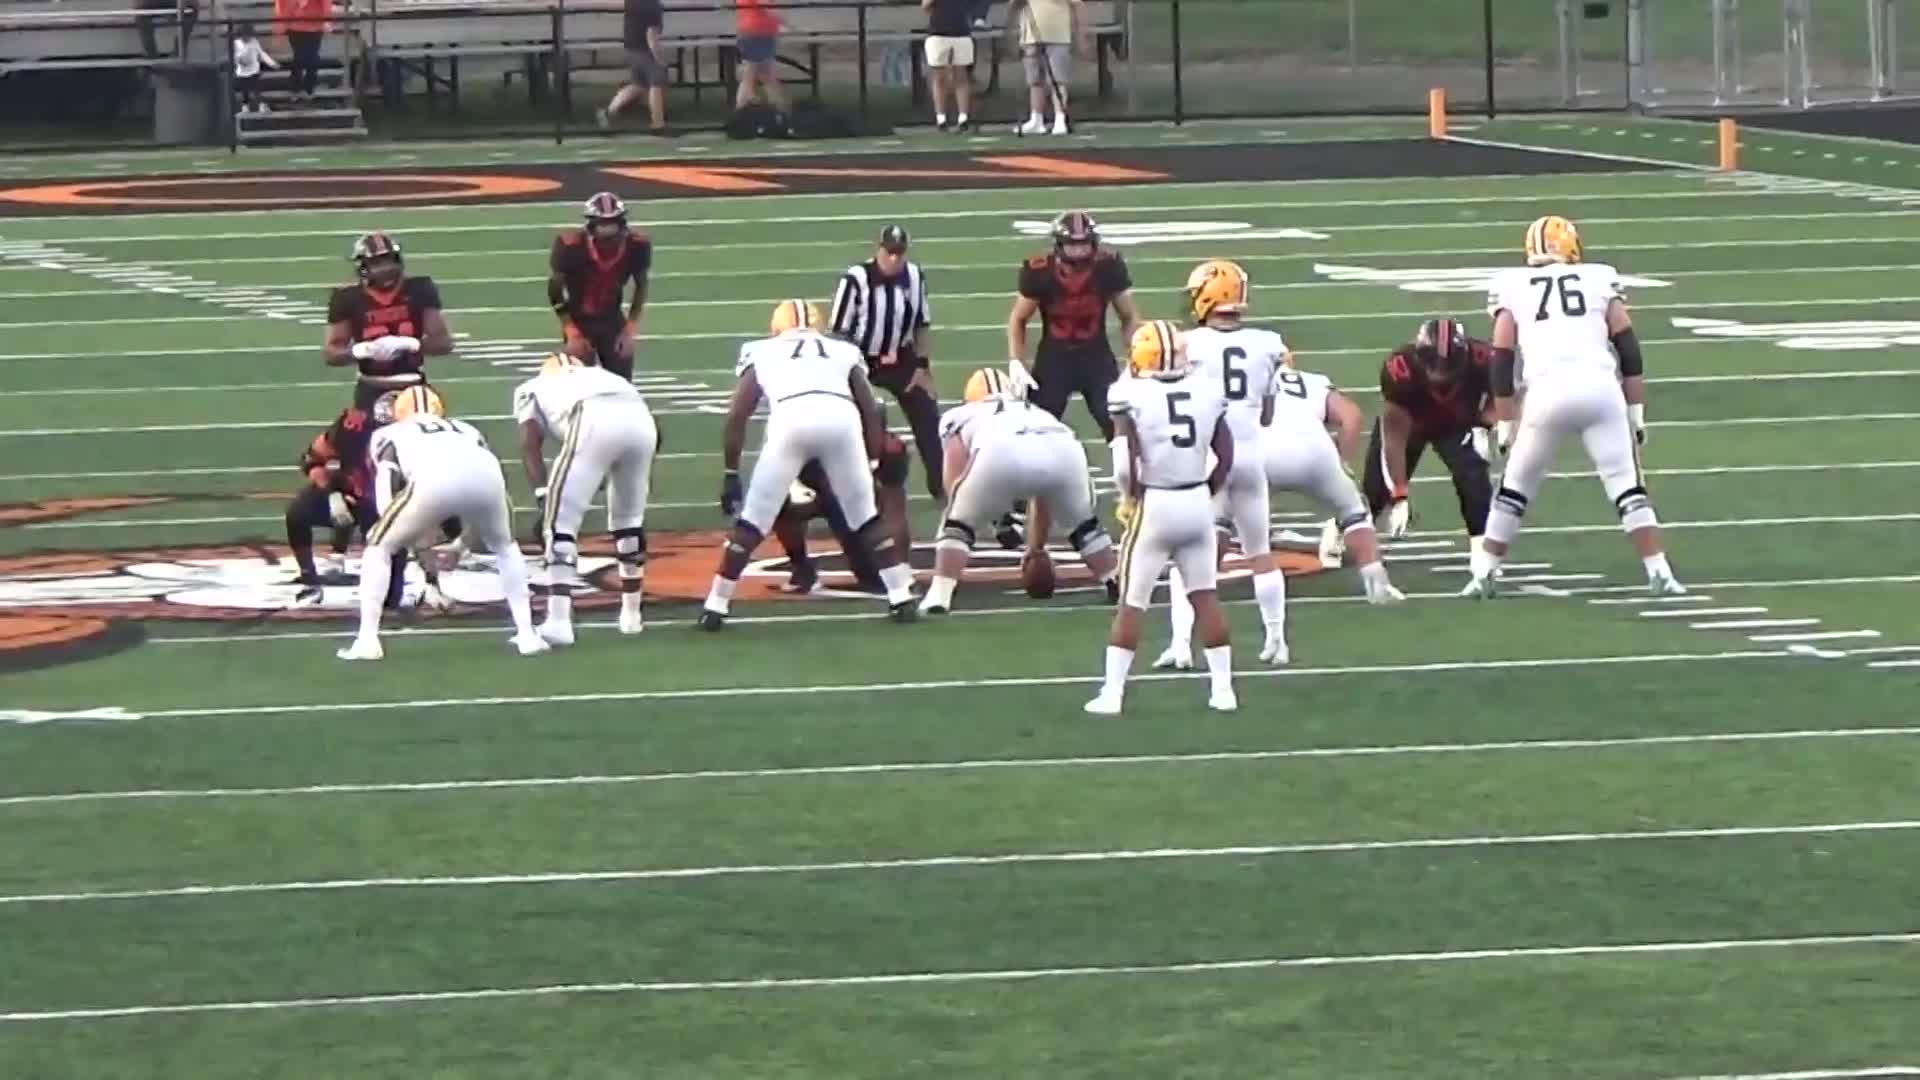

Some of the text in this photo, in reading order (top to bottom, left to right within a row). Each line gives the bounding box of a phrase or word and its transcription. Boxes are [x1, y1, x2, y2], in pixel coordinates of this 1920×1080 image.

[1530, 273, 1586, 321] 76
[788, 337, 830, 360] 71
[1223, 346, 1248, 400] 6
[1275, 372, 1307, 399] 9
[1166, 391, 1196, 448] 5
